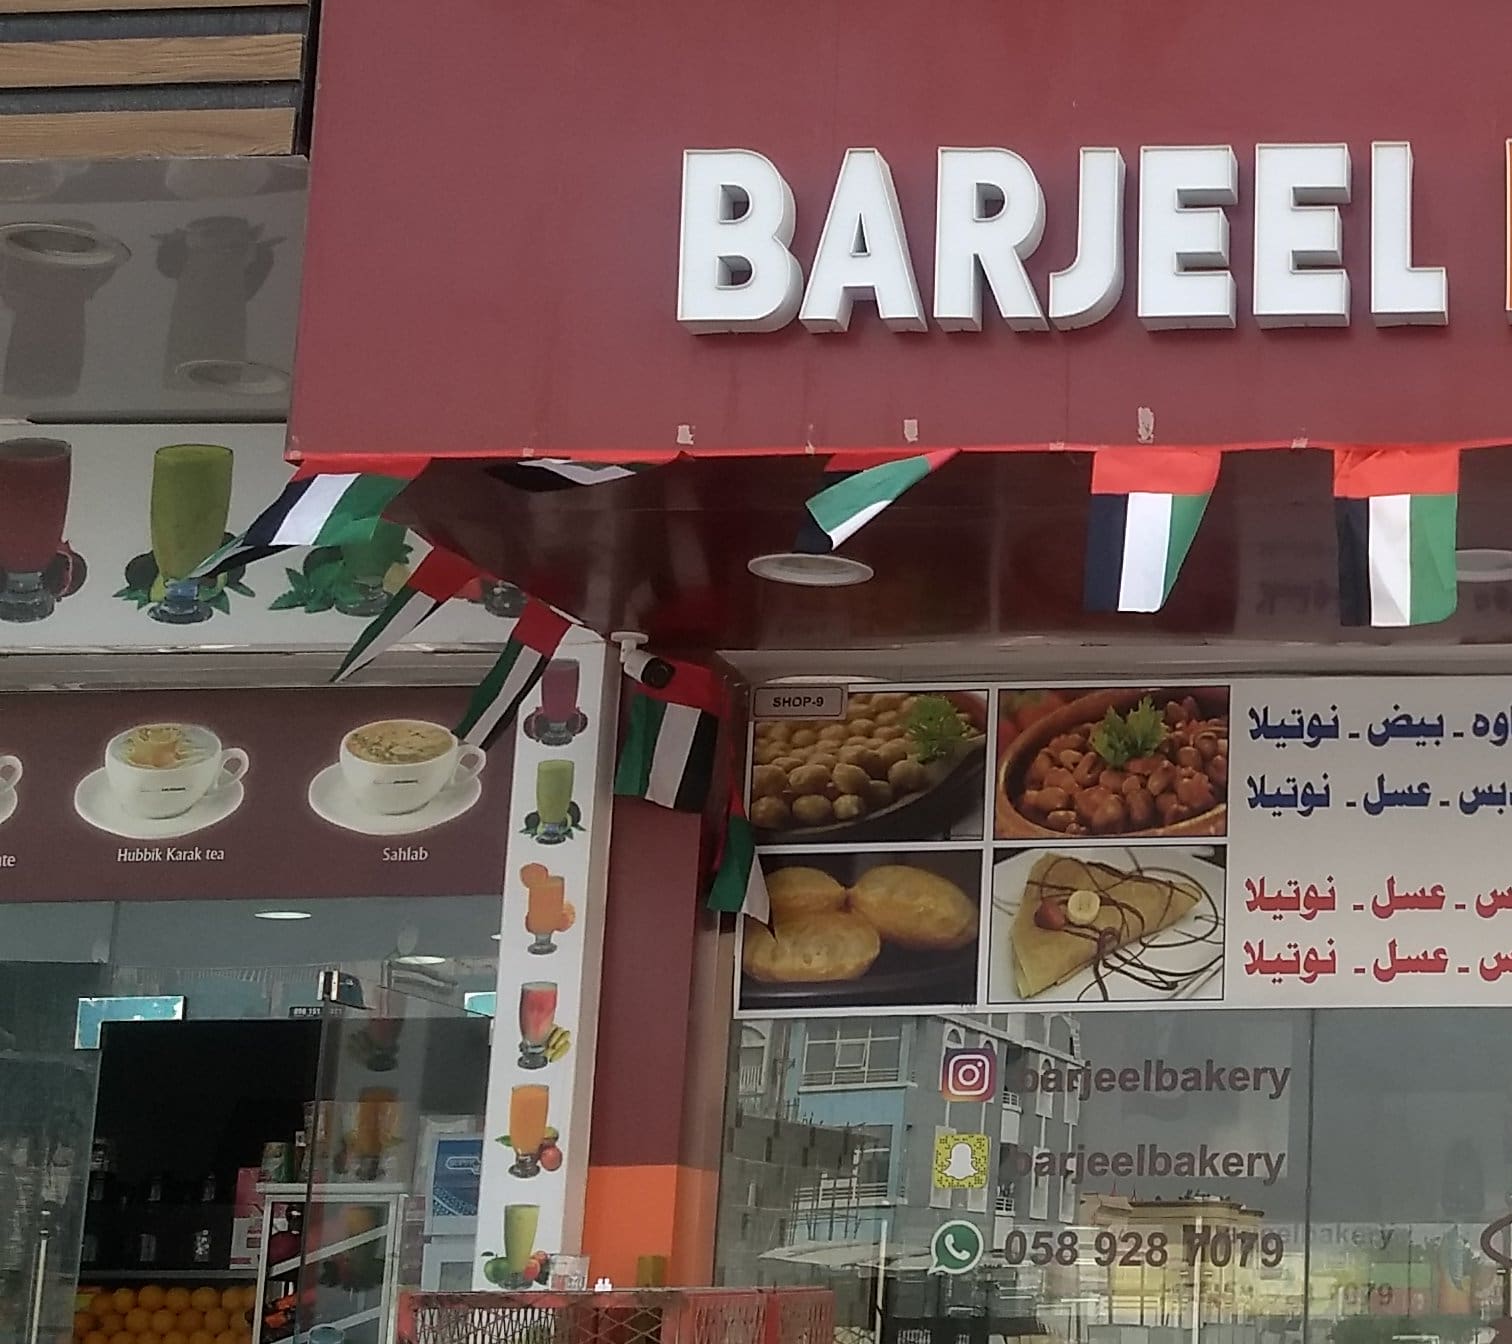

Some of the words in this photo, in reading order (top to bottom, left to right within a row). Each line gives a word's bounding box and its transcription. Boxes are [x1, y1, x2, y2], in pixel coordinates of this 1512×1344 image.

[676, 141, 1450, 335] BARJEEL
[772, 696, 824, 708] SHOP-9
[1249, 704, 1340, 748] نوتيلا
[1367, 704, 1444, 747] بيض
[1247, 771, 1330, 817] نوتيلا
[1363, 773, 1432, 816] عسل
[117, 848, 162, 862] Hubbik
[166, 847, 202, 862] Karak
[205, 848, 225, 861] tea
[382, 847, 428, 861] Sahlab
[1245, 875, 1336, 921] نوتيلا
[1371, 875, 1446, 919] عسل
[1243, 938, 1336, 984] نوتيلا
[1372, 938, 1448, 983] عسل
[1004, 1230, 1079, 1267] 058
[1094, 1230, 1169, 1267] 928
